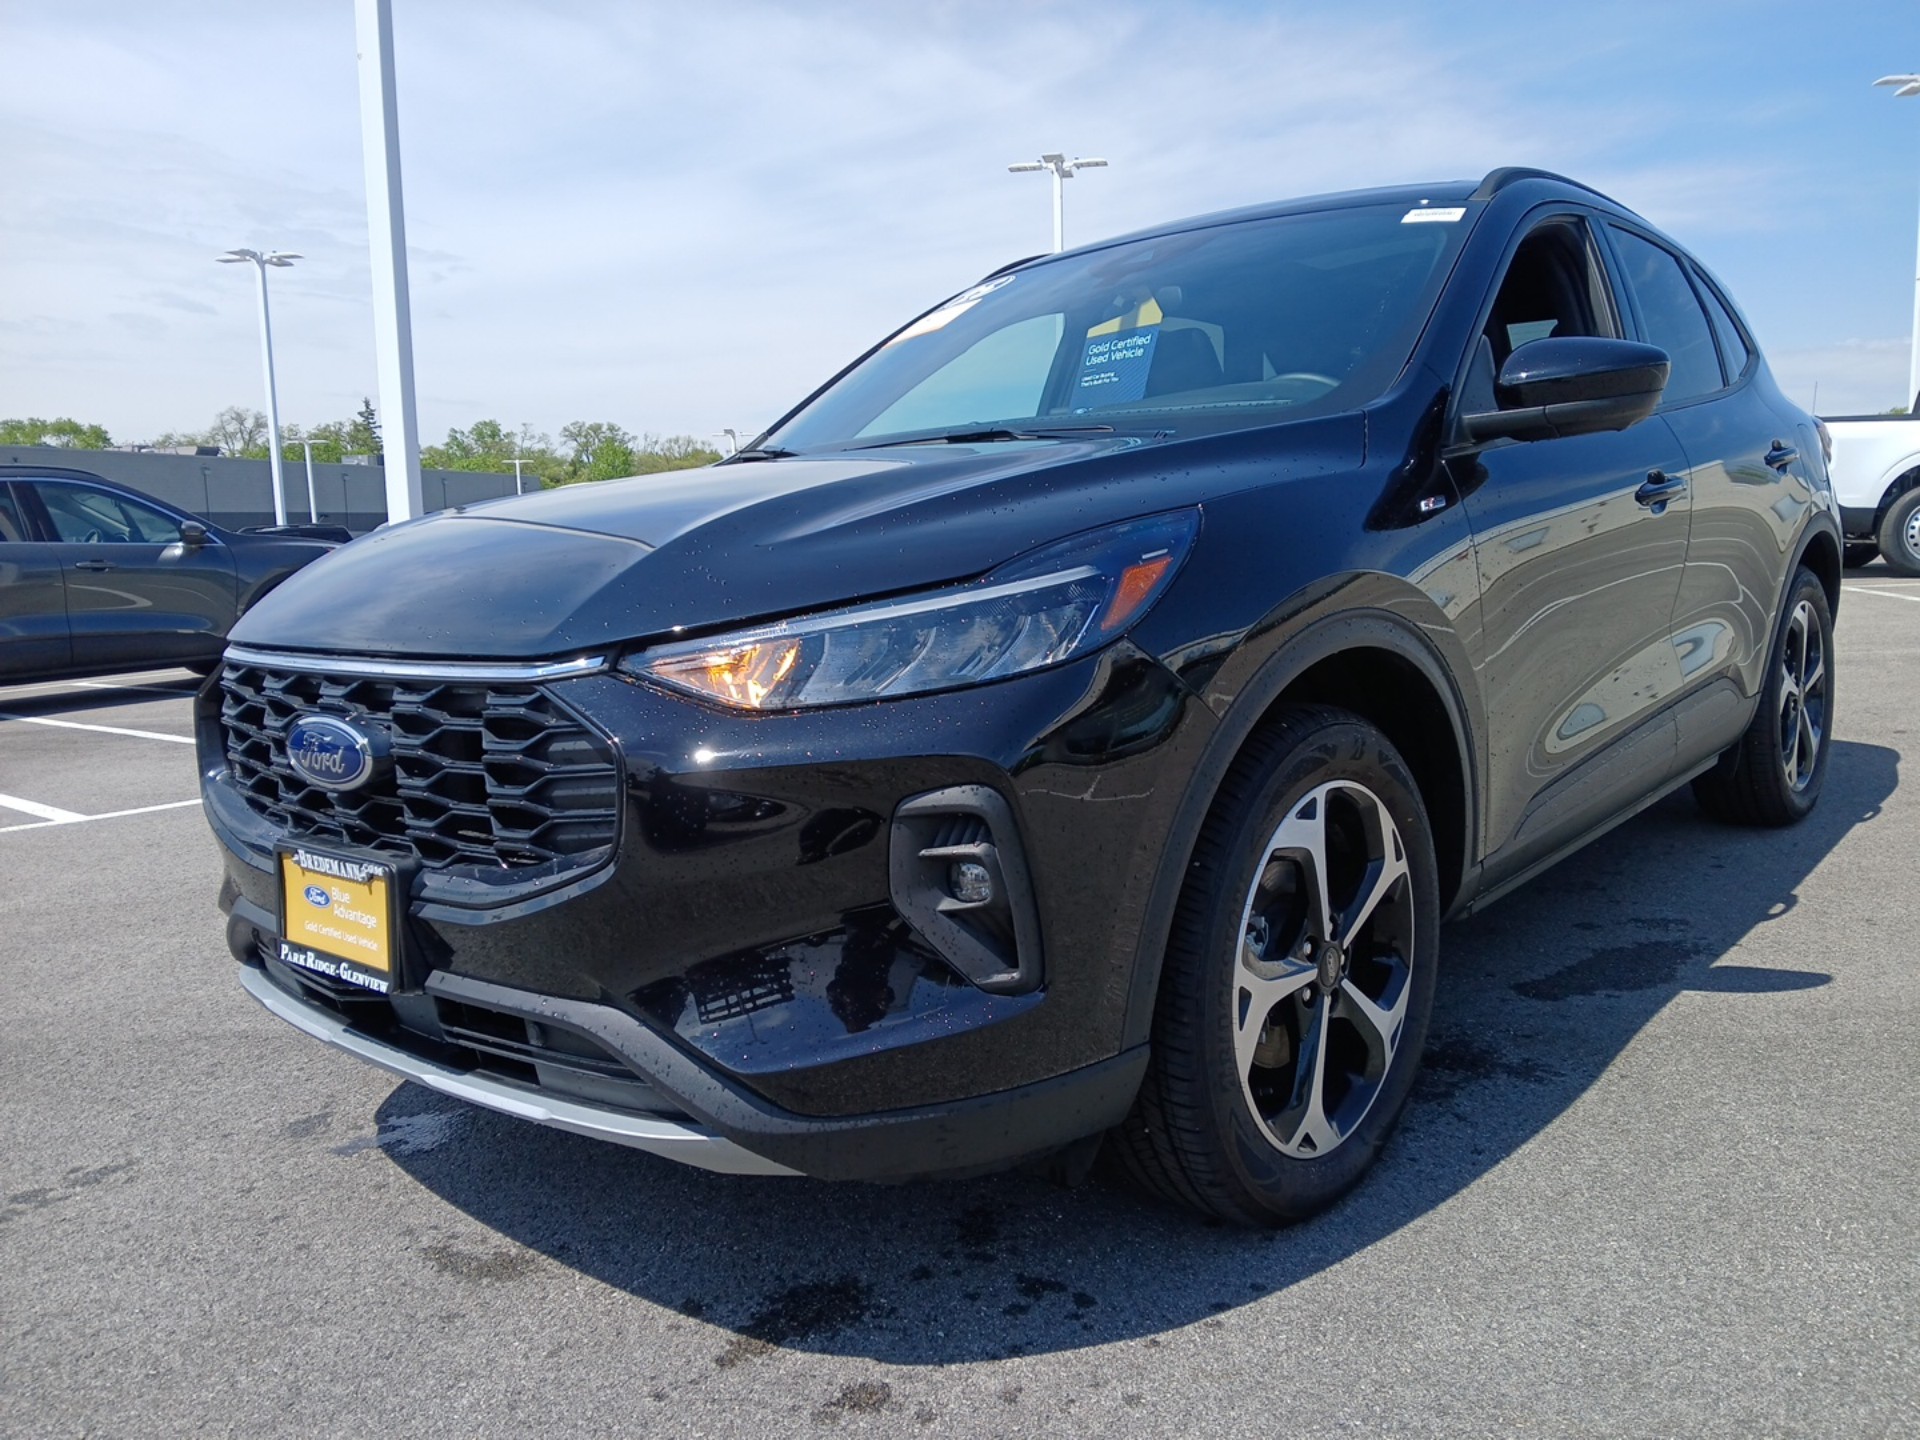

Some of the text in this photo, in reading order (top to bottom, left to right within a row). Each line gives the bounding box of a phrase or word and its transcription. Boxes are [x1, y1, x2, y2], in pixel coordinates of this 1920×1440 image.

[1088, 334, 1152, 355] Gold Certified
[1085, 347, 1144, 366] Used Vehicle
[300, 731, 345, 774] Ford
[331, 886, 350, 904] Blue
[333, 903, 377, 929] Advantage
[304, 920, 378, 951] Gold Certified Used Vehicle
